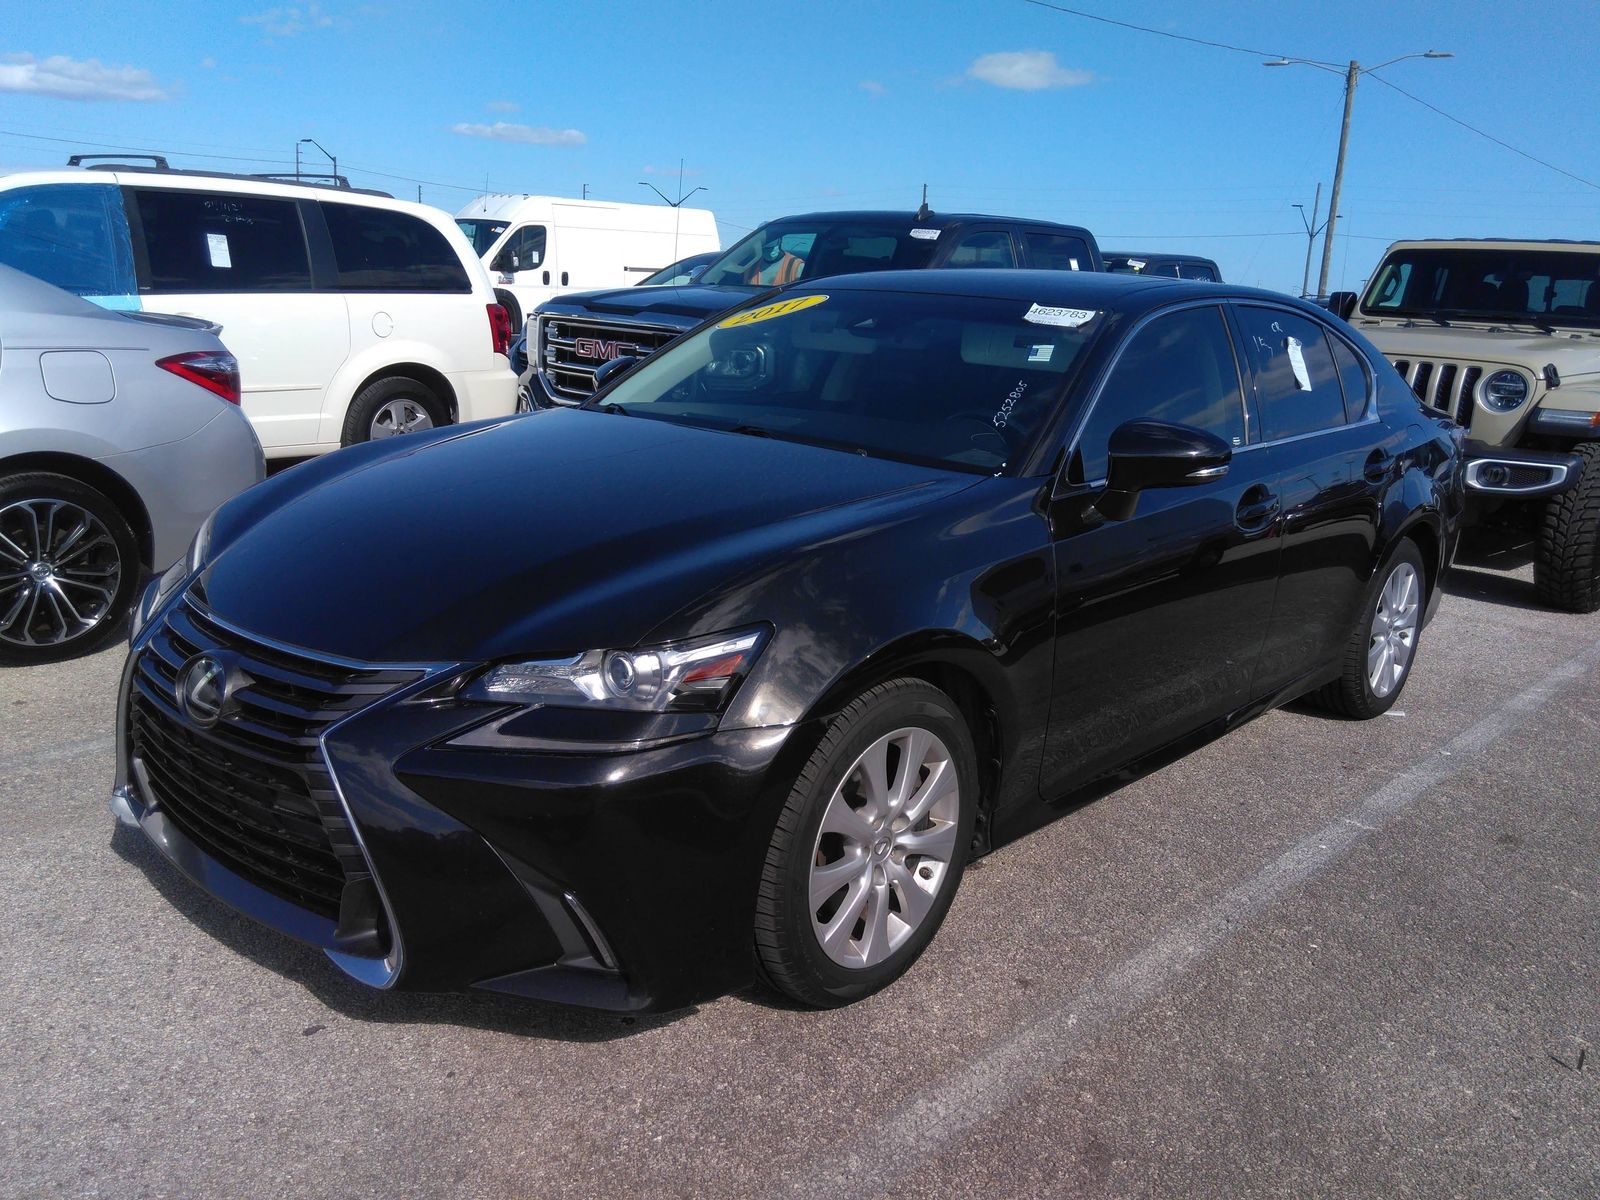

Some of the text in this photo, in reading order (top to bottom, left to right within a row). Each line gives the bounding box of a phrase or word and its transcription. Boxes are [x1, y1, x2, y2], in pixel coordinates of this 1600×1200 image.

[731, 297, 811, 325] 2017
[1030, 307, 1088, 319] 4623783
[992, 380, 1028, 428] 5252805
